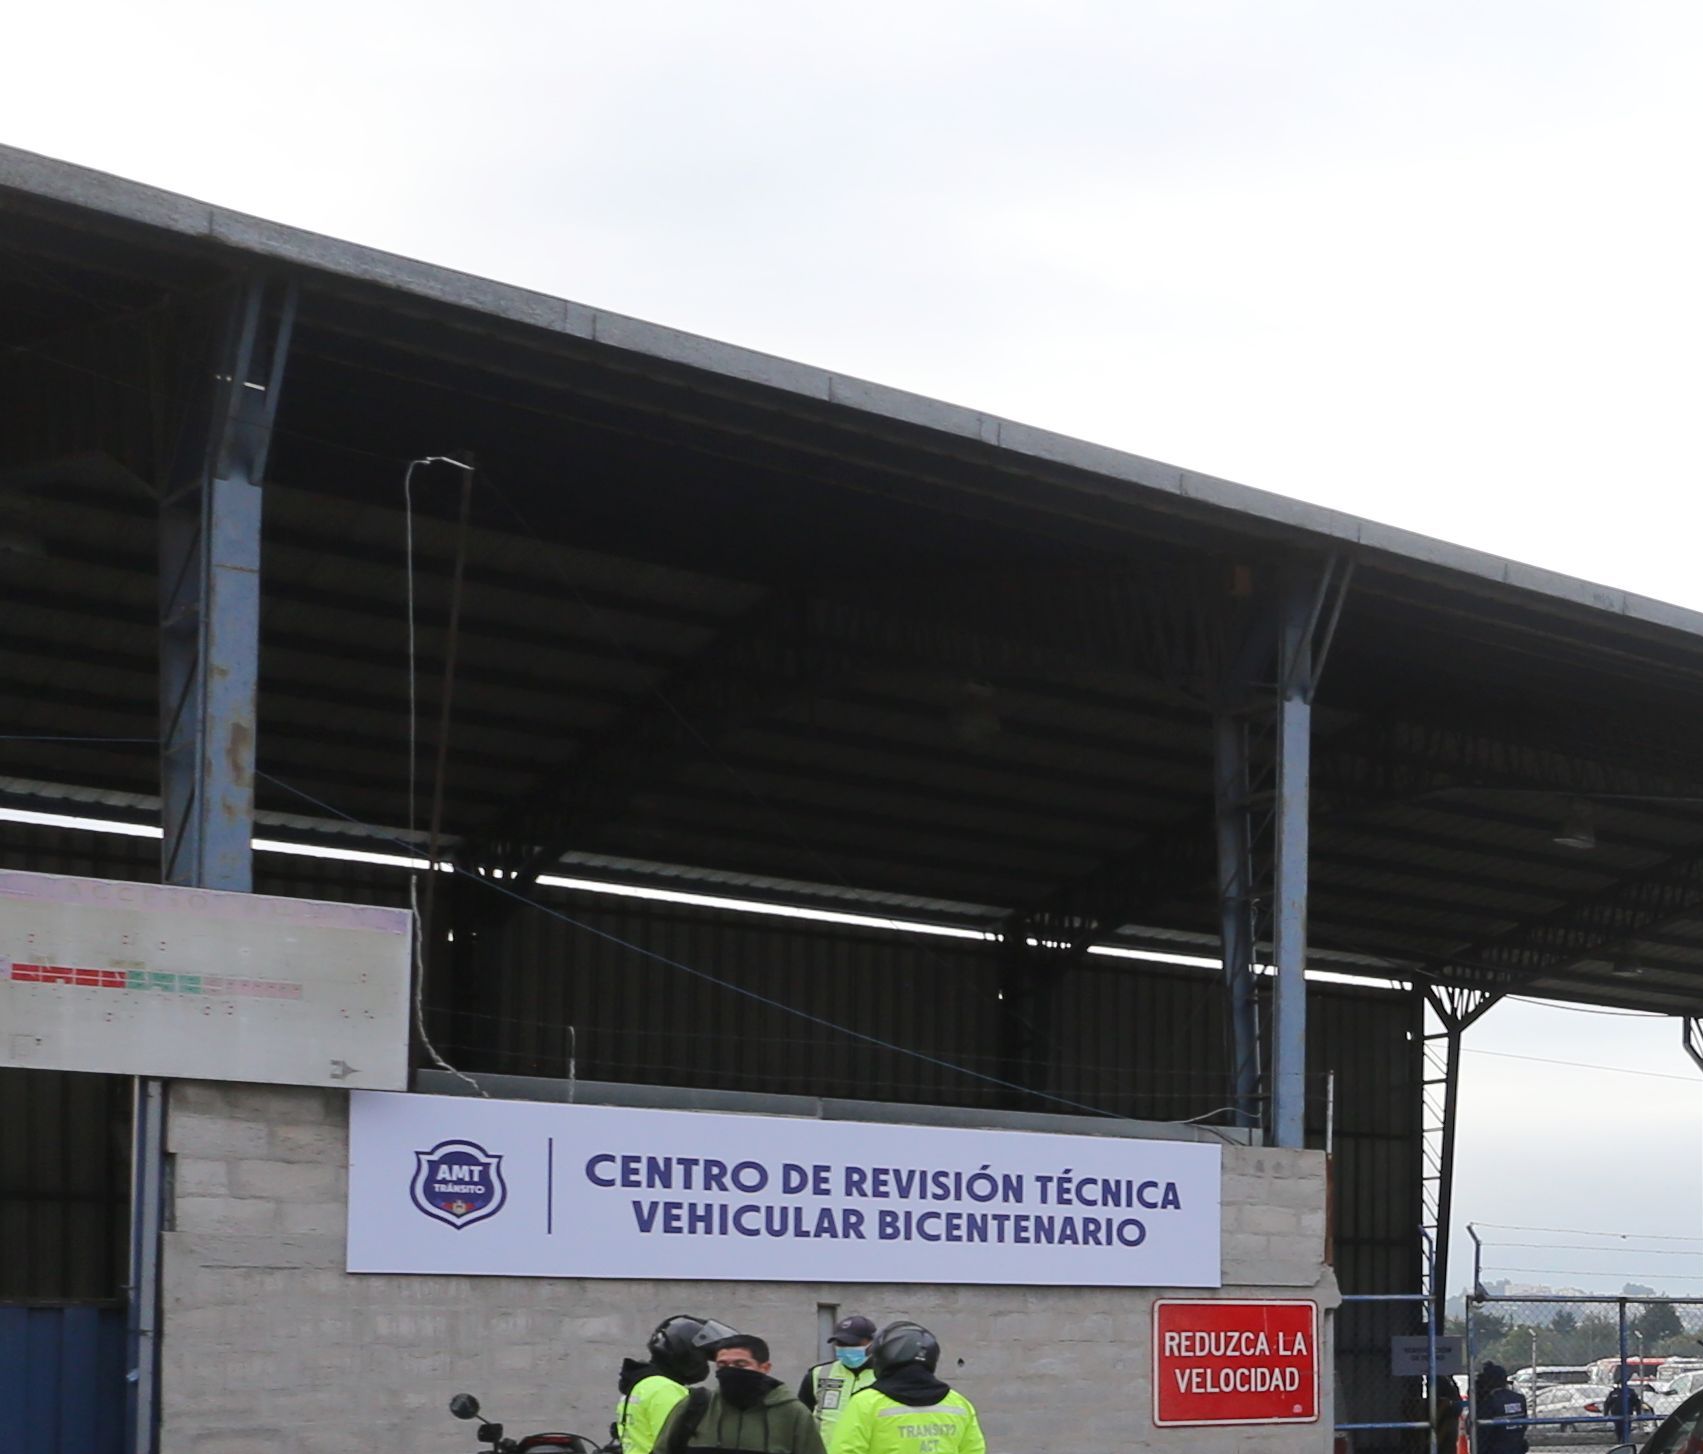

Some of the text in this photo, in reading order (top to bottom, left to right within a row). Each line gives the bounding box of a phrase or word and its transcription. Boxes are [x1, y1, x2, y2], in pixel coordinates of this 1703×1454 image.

[436, 1164, 484, 1182] AMT
[585, 1154, 1182, 1210] CENTRO DE REVISIÓN TÉCNICA
[632, 1200, 1147, 1247] VEHICULAR BICENTENARIO
[1164, 1331, 1308, 1357] REDUZCA LA
[1174, 1367, 1300, 1393] VELOCIDAD
